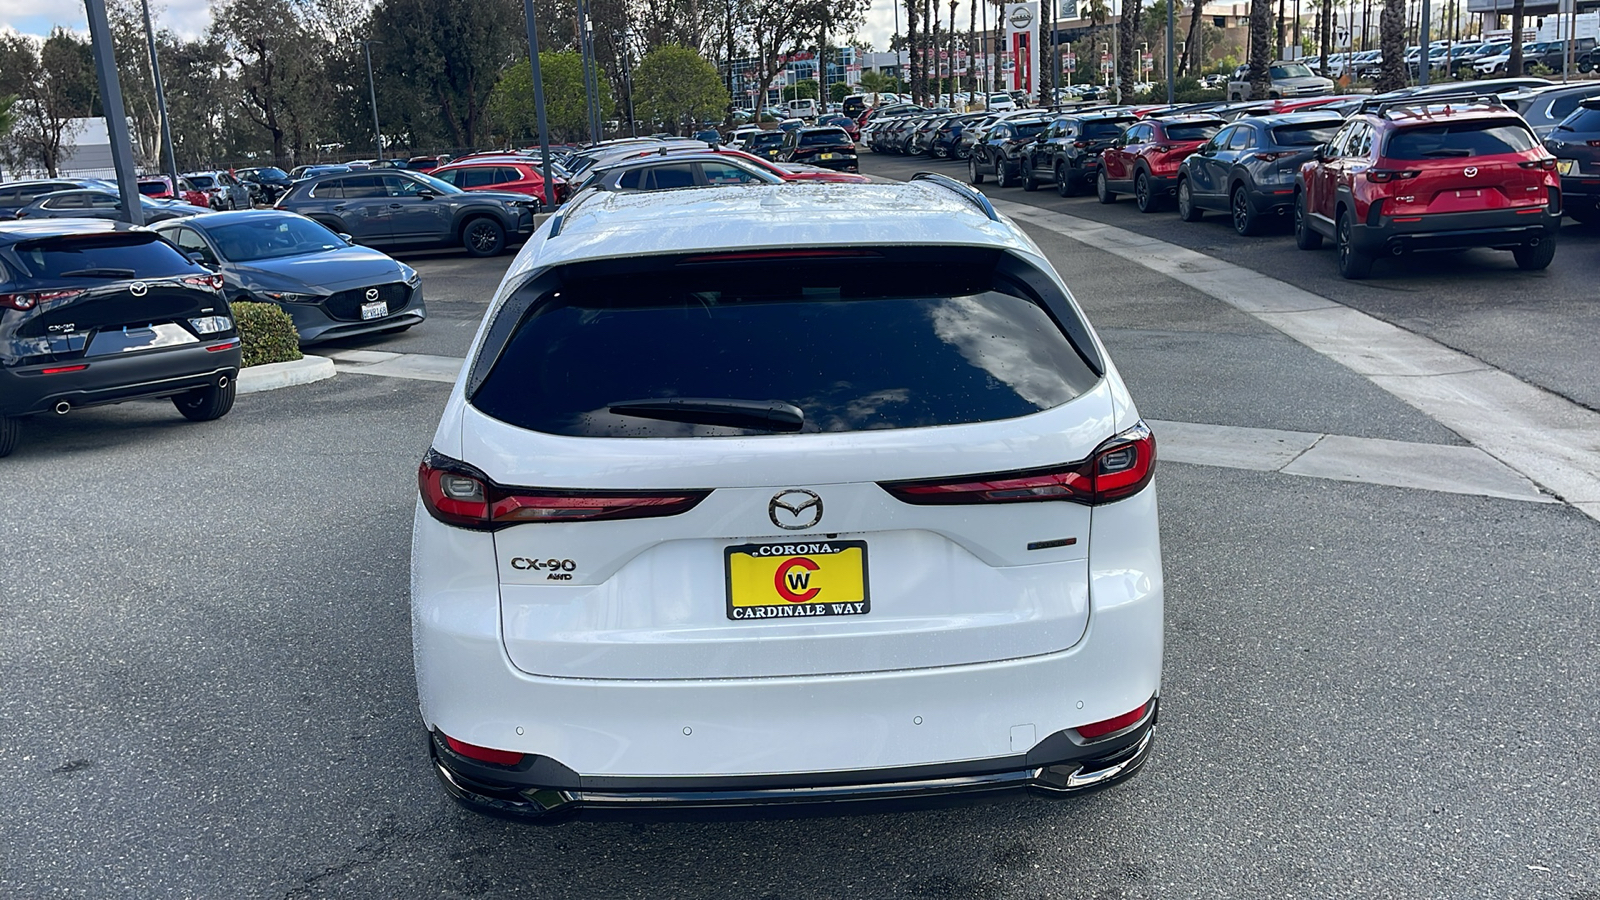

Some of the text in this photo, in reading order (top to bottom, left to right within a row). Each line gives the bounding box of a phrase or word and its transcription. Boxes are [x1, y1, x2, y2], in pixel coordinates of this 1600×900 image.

[759, 543, 832, 556] CORONA
[511, 557, 577, 572] CX-90
[733, 602, 865, 619] CARDINALE WAY
